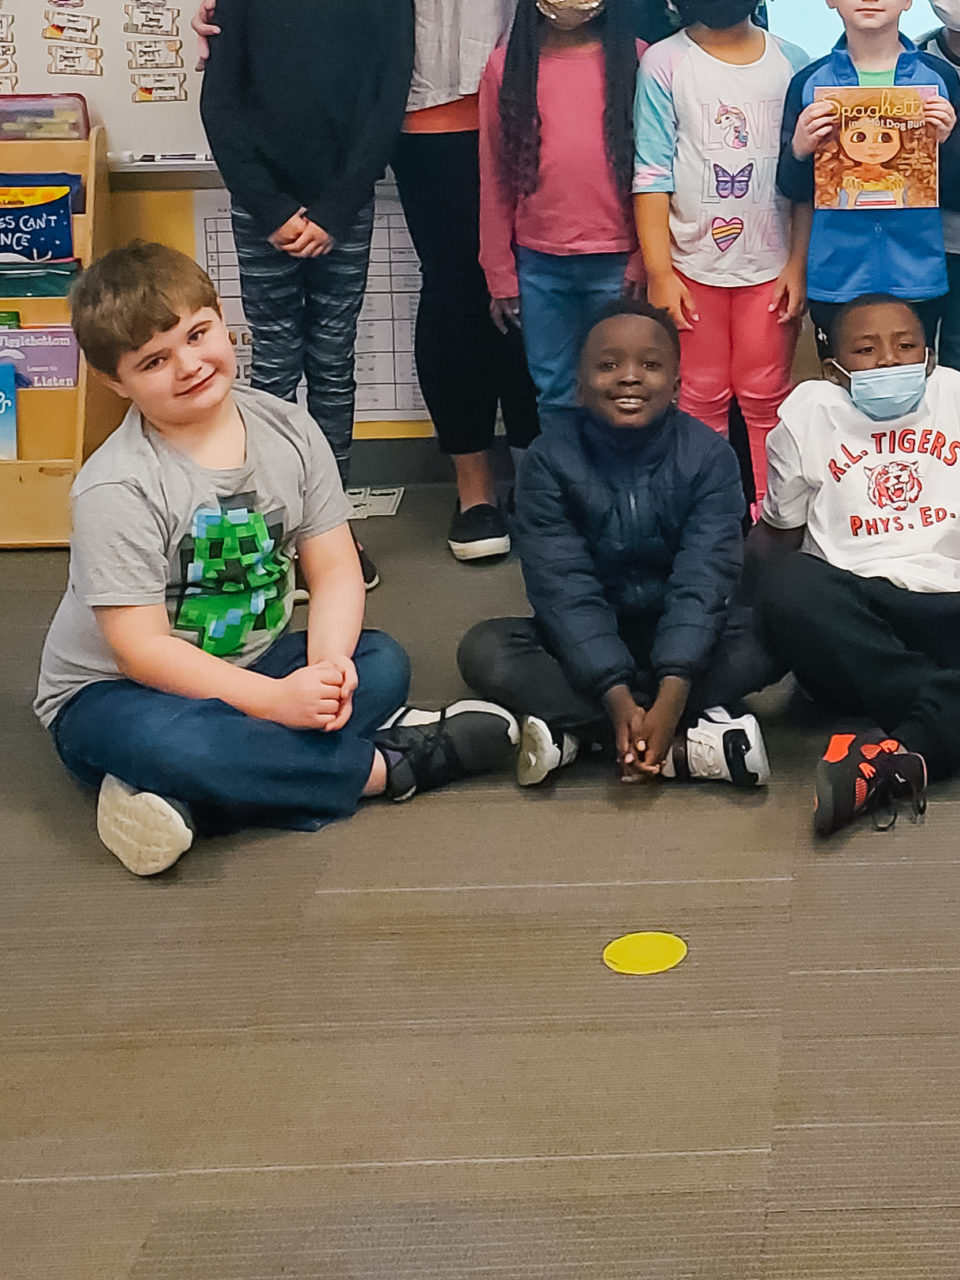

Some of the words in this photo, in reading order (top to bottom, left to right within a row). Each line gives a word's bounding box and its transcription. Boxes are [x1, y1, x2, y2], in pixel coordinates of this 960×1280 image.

[828, 444, 868, 482] R.L.
[849, 515, 915, 537] PHYS.
[920, 506, 955, 527] ED.
